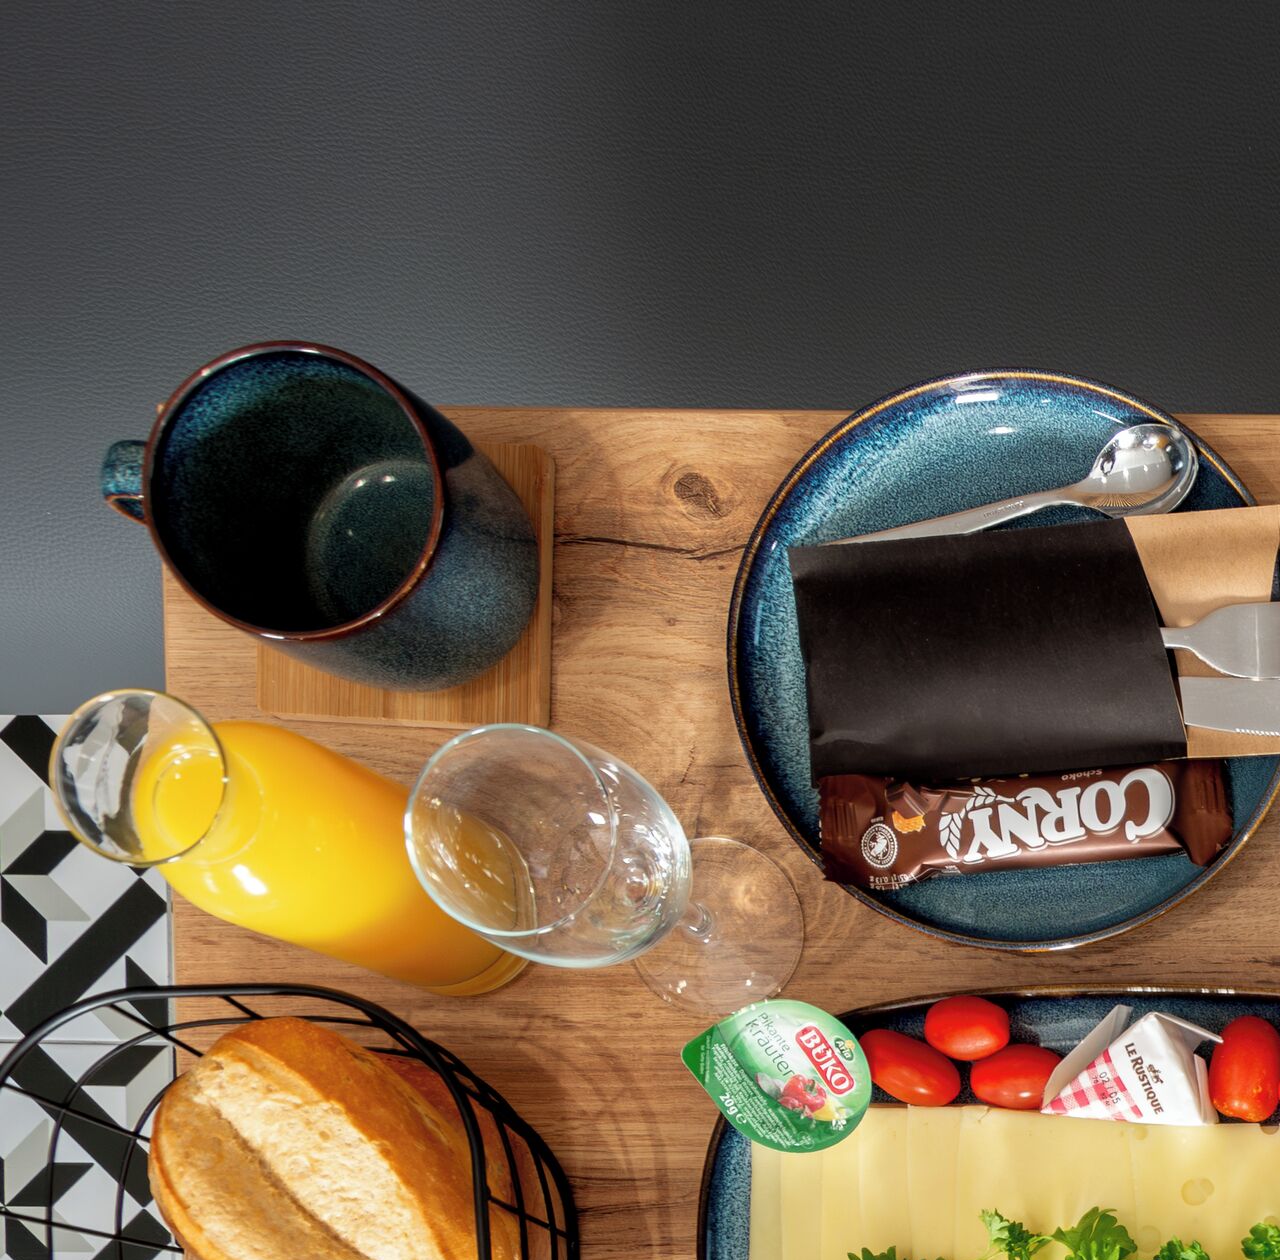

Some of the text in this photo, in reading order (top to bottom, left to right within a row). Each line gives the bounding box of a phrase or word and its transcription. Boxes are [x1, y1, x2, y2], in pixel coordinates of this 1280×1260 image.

[1061, 769, 1103, 780] Schoko
[962, 768, 1174, 864] CORNY
[746, 1019, 796, 1077] Kräuter
[758, 1013, 791, 1052] Pikante
[835, 1040, 850, 1059] Arla
[800, 1030, 849, 1094] BUKO
[1125, 1043, 1164, 1115] LE RUSTIQUE
